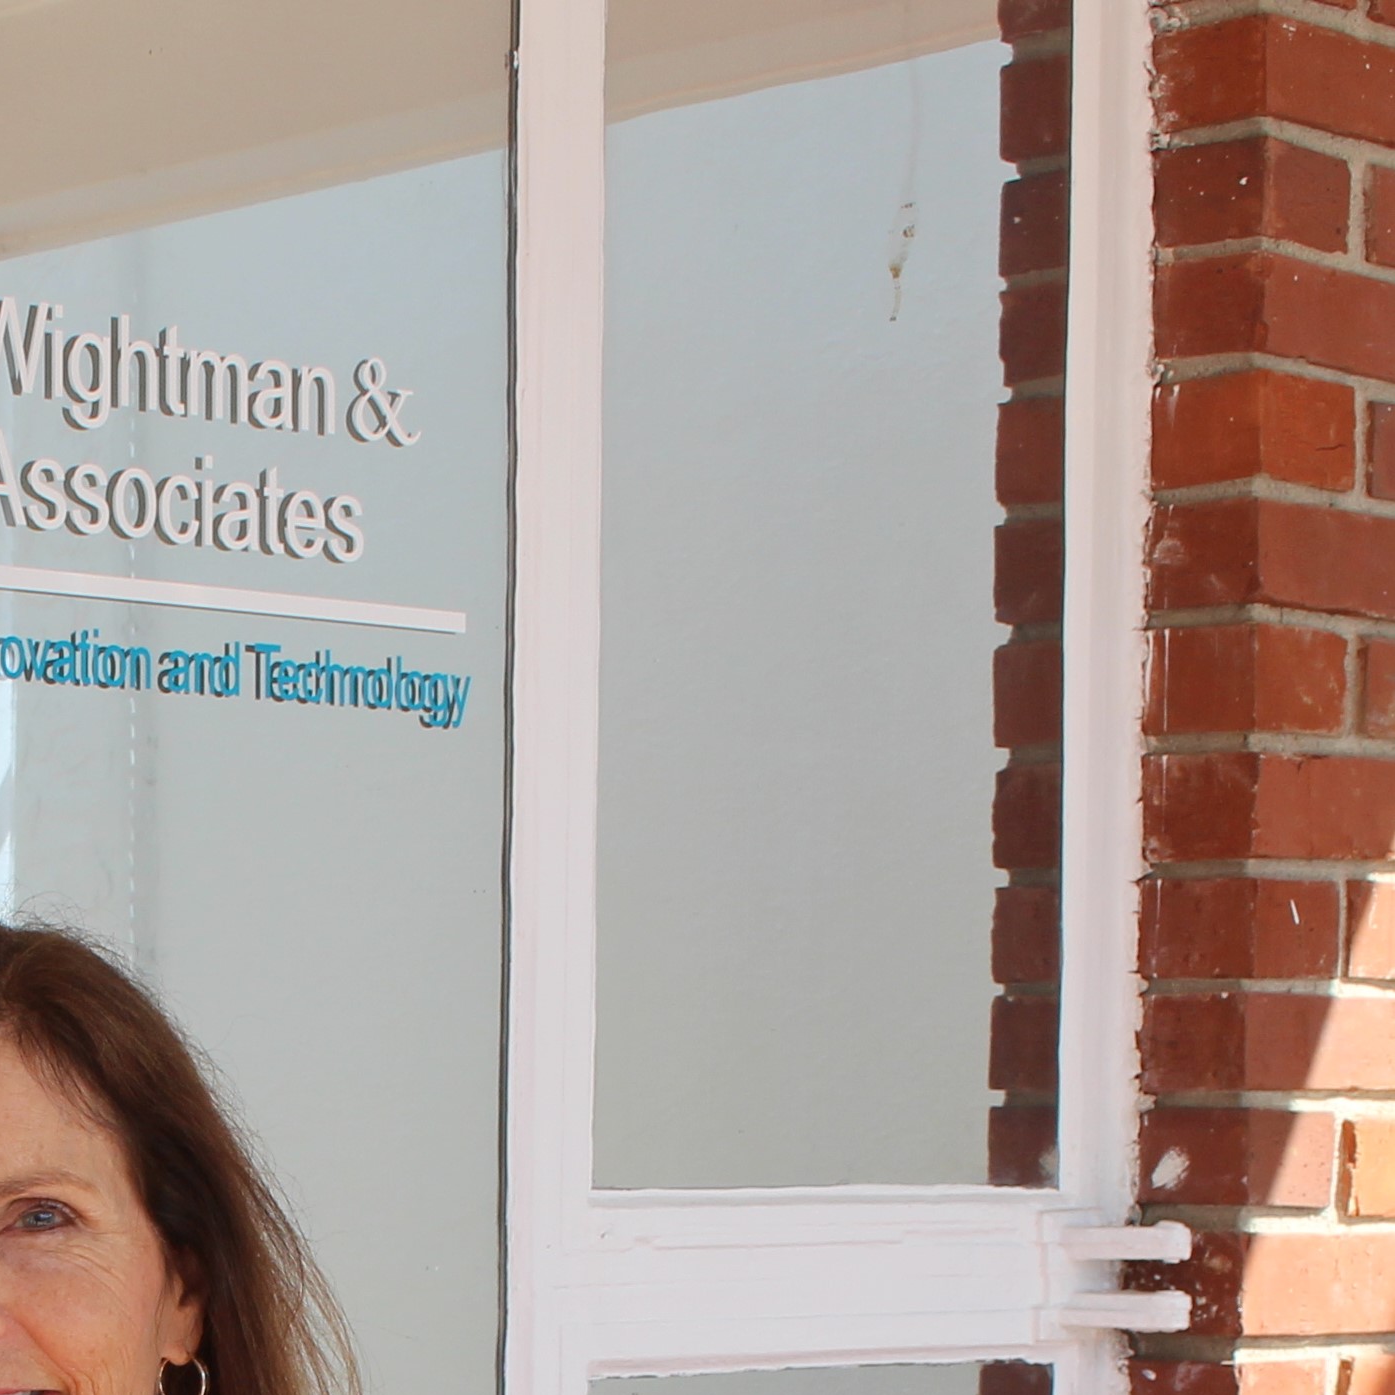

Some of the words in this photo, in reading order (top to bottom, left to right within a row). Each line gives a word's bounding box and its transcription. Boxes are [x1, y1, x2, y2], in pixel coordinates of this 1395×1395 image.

[350, 357, 422, 445] &
[167, 641, 240, 697] and
[254, 642, 471, 728] Technology
